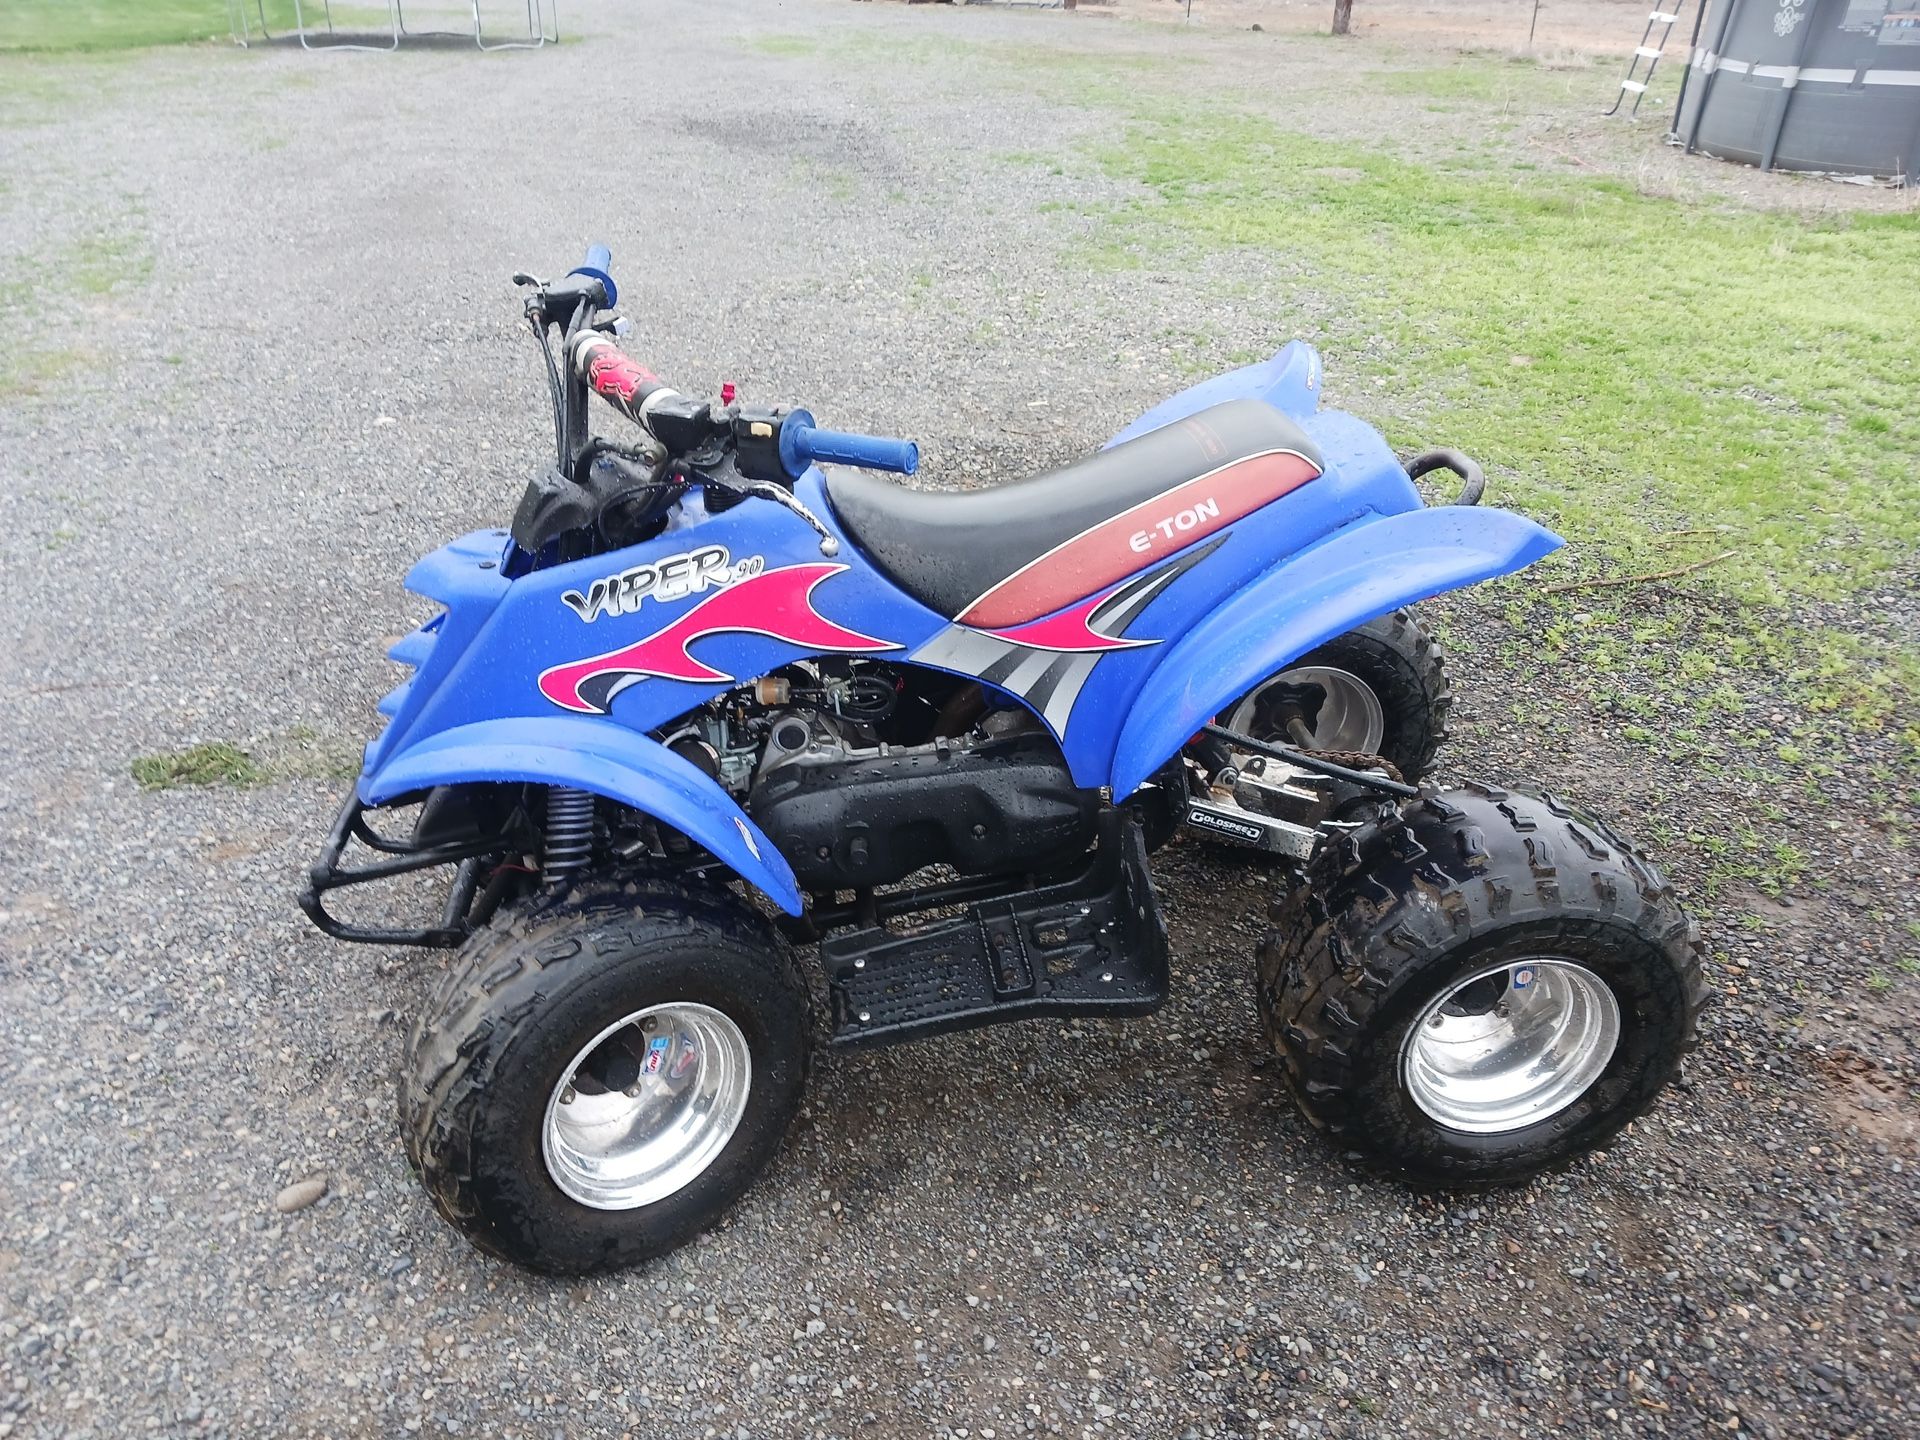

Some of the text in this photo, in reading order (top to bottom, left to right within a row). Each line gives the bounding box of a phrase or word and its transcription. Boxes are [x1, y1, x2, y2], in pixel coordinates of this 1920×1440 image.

[1129, 497, 1220, 553] E-TON
[562, 545, 763, 622] VIPER 90
[1190, 811, 1260, 838] GOLDSPEED
